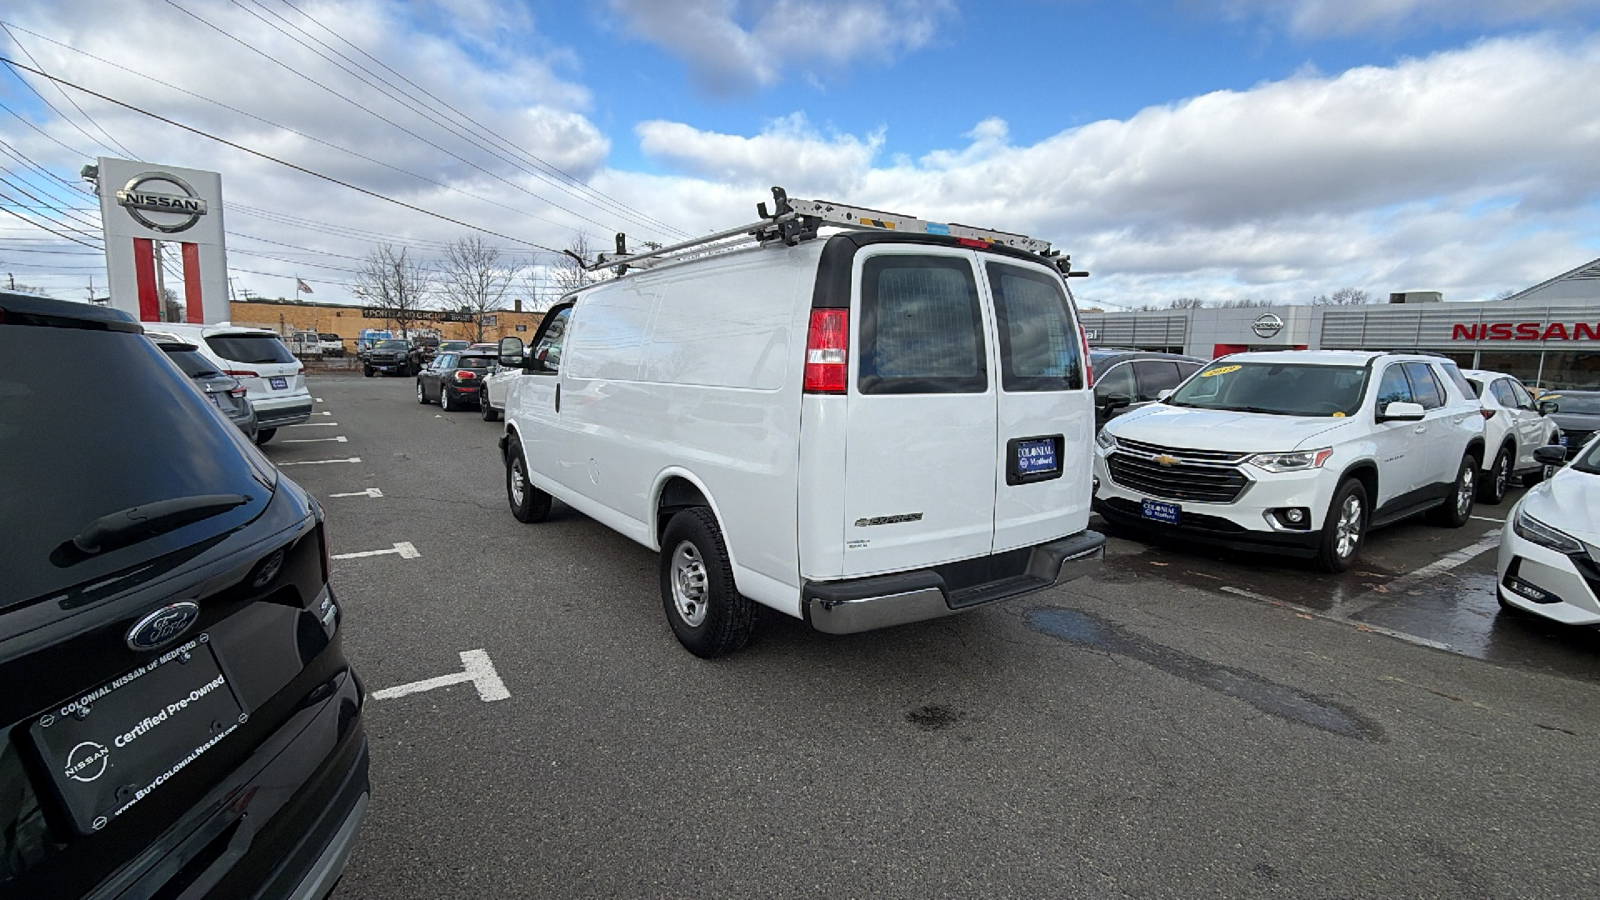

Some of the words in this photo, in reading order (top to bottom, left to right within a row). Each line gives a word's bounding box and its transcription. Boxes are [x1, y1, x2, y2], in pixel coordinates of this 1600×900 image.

[125, 193, 199, 211] NISSAN
[1452, 322, 1600, 340] NISSAN
[868, 512, 923, 526] EXPRESS
[150, 612, 188, 642] Ford
[60, 685, 112, 716] COLONIAL
[112, 667, 146, 689] NISSAN
[147, 660, 159, 671] OF
[159, 640, 197, 664] MEDFORD
[114, 708, 168, 748] Certified
[166, 674, 225, 716] Pre-Owned
[65, 746, 109, 777] NISSAN
